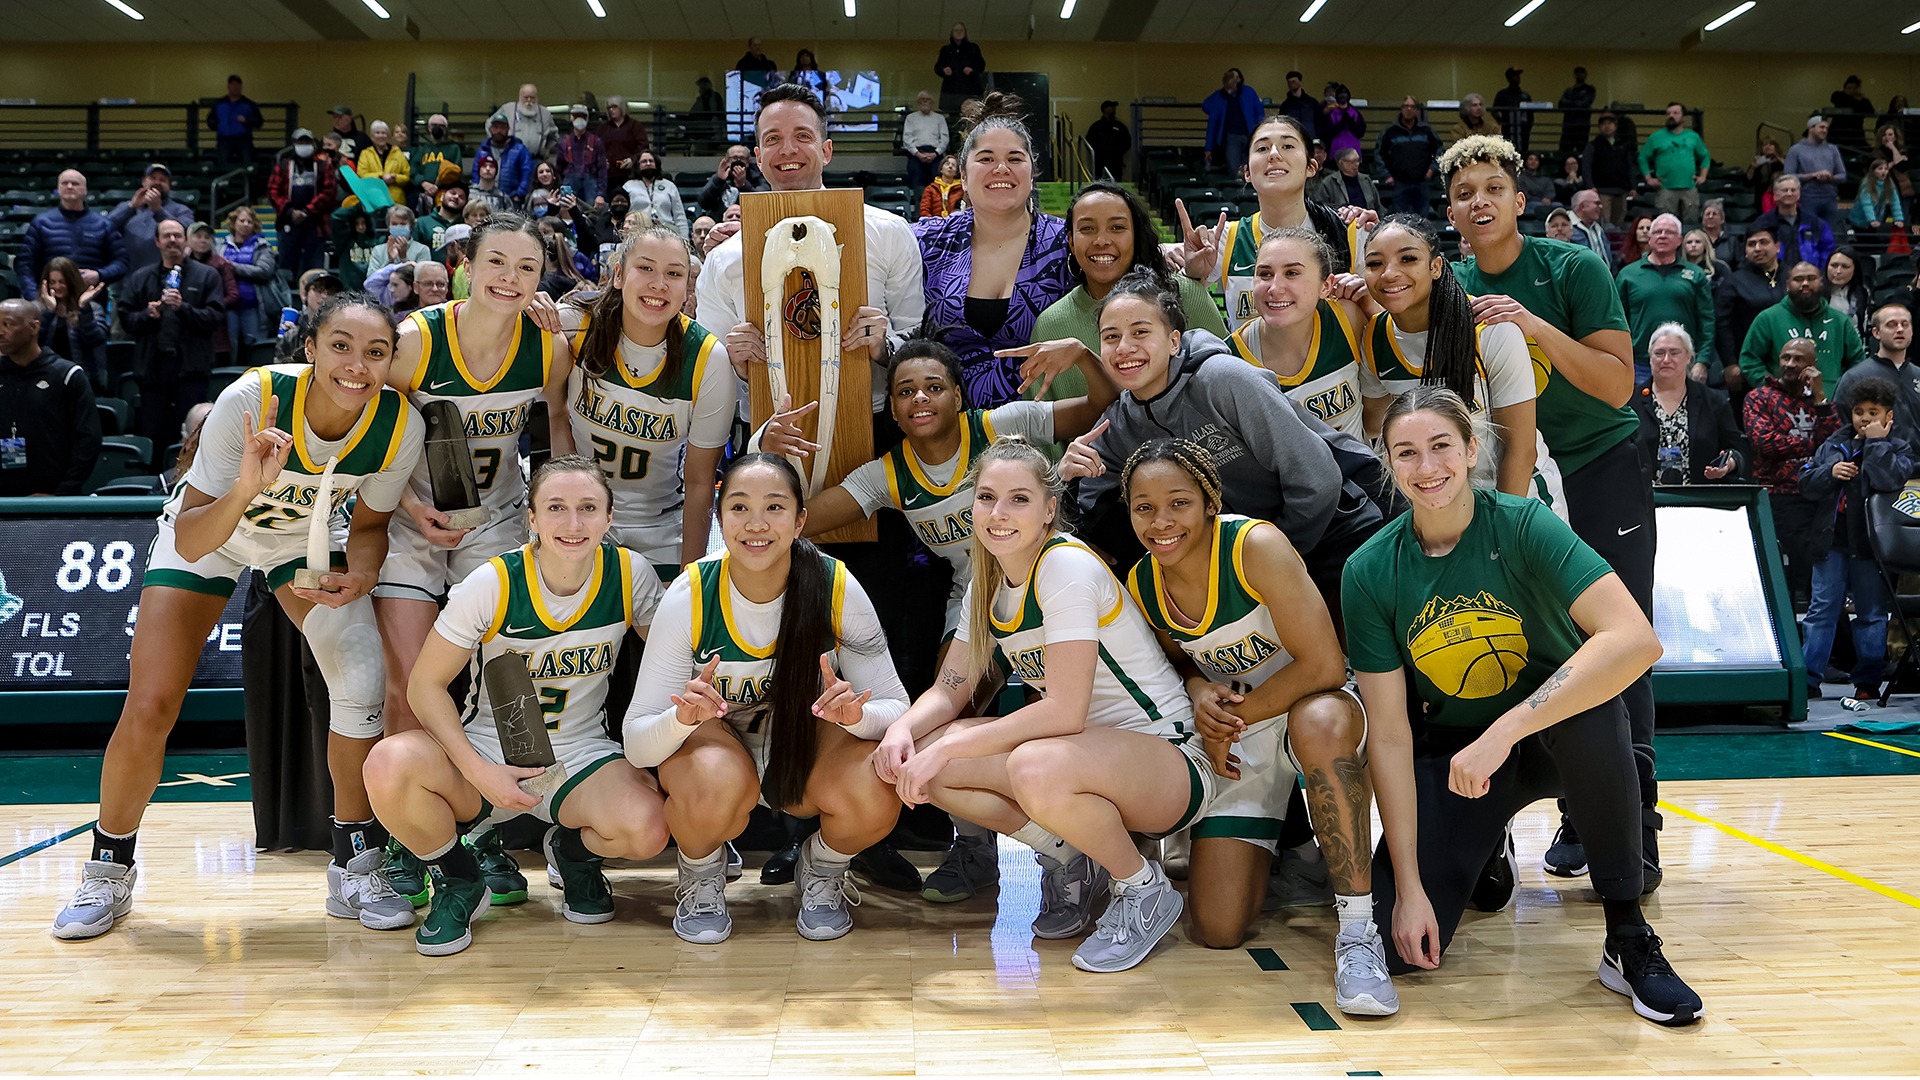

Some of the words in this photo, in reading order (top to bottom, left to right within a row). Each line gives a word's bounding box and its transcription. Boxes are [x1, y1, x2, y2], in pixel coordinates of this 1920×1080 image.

[1788, 328, 1828, 341] UAA
[1191, 423, 1221, 443] ALASK
[55, 541, 136, 593] 88
[21, 612, 81, 637] FLS
[12, 652, 73, 677] TOL
[505, 640, 613, 682] LASKA
